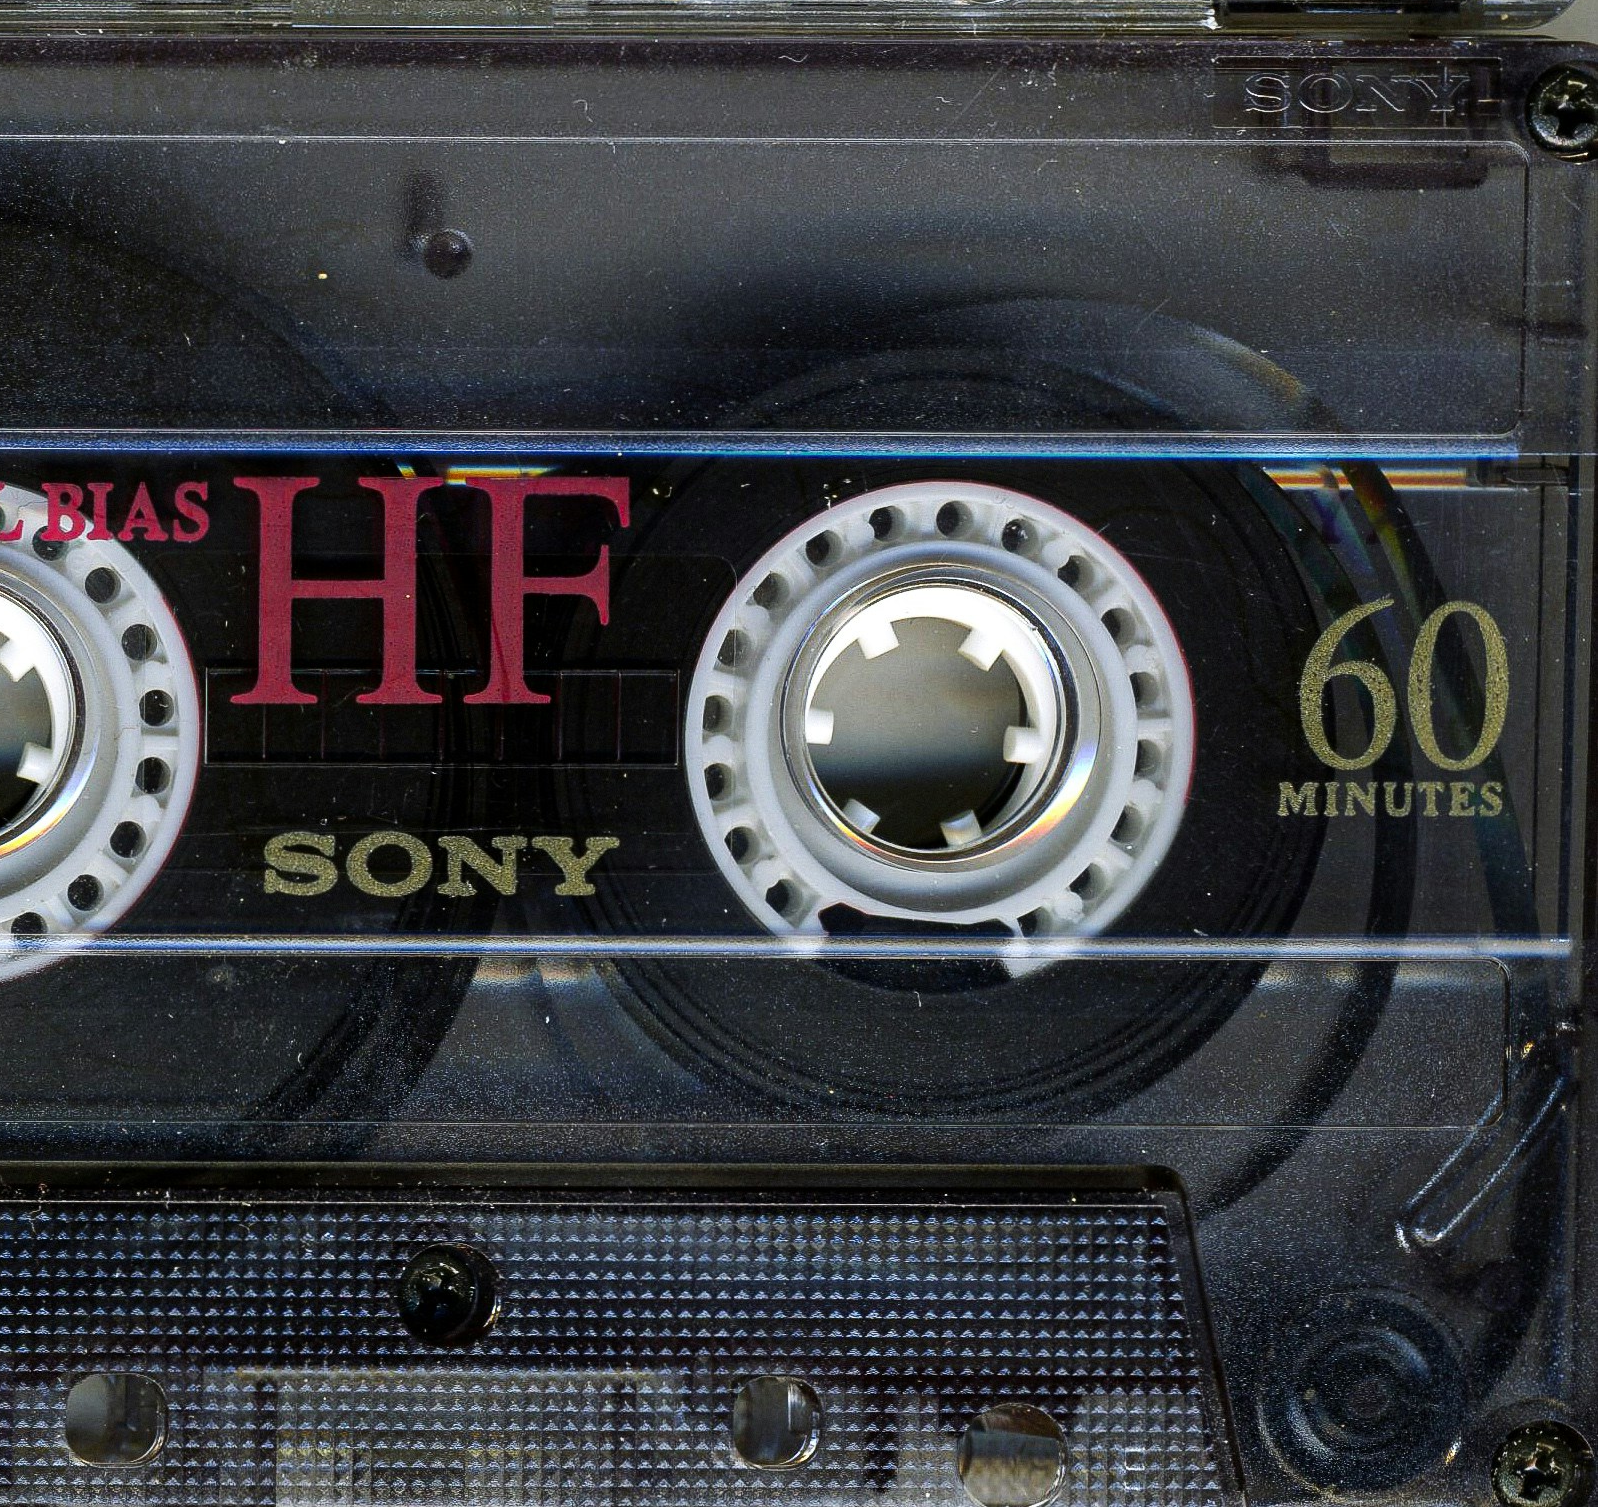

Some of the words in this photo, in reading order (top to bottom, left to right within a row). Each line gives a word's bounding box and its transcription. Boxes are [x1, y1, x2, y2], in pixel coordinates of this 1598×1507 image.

[43, 481, 209, 542] BIAS
[230, 477, 630, 705] HF
[1299, 597, 1510, 770] 60
[1276, 781, 1504, 817] MINUTES
[263, 831, 620, 898] SONY
